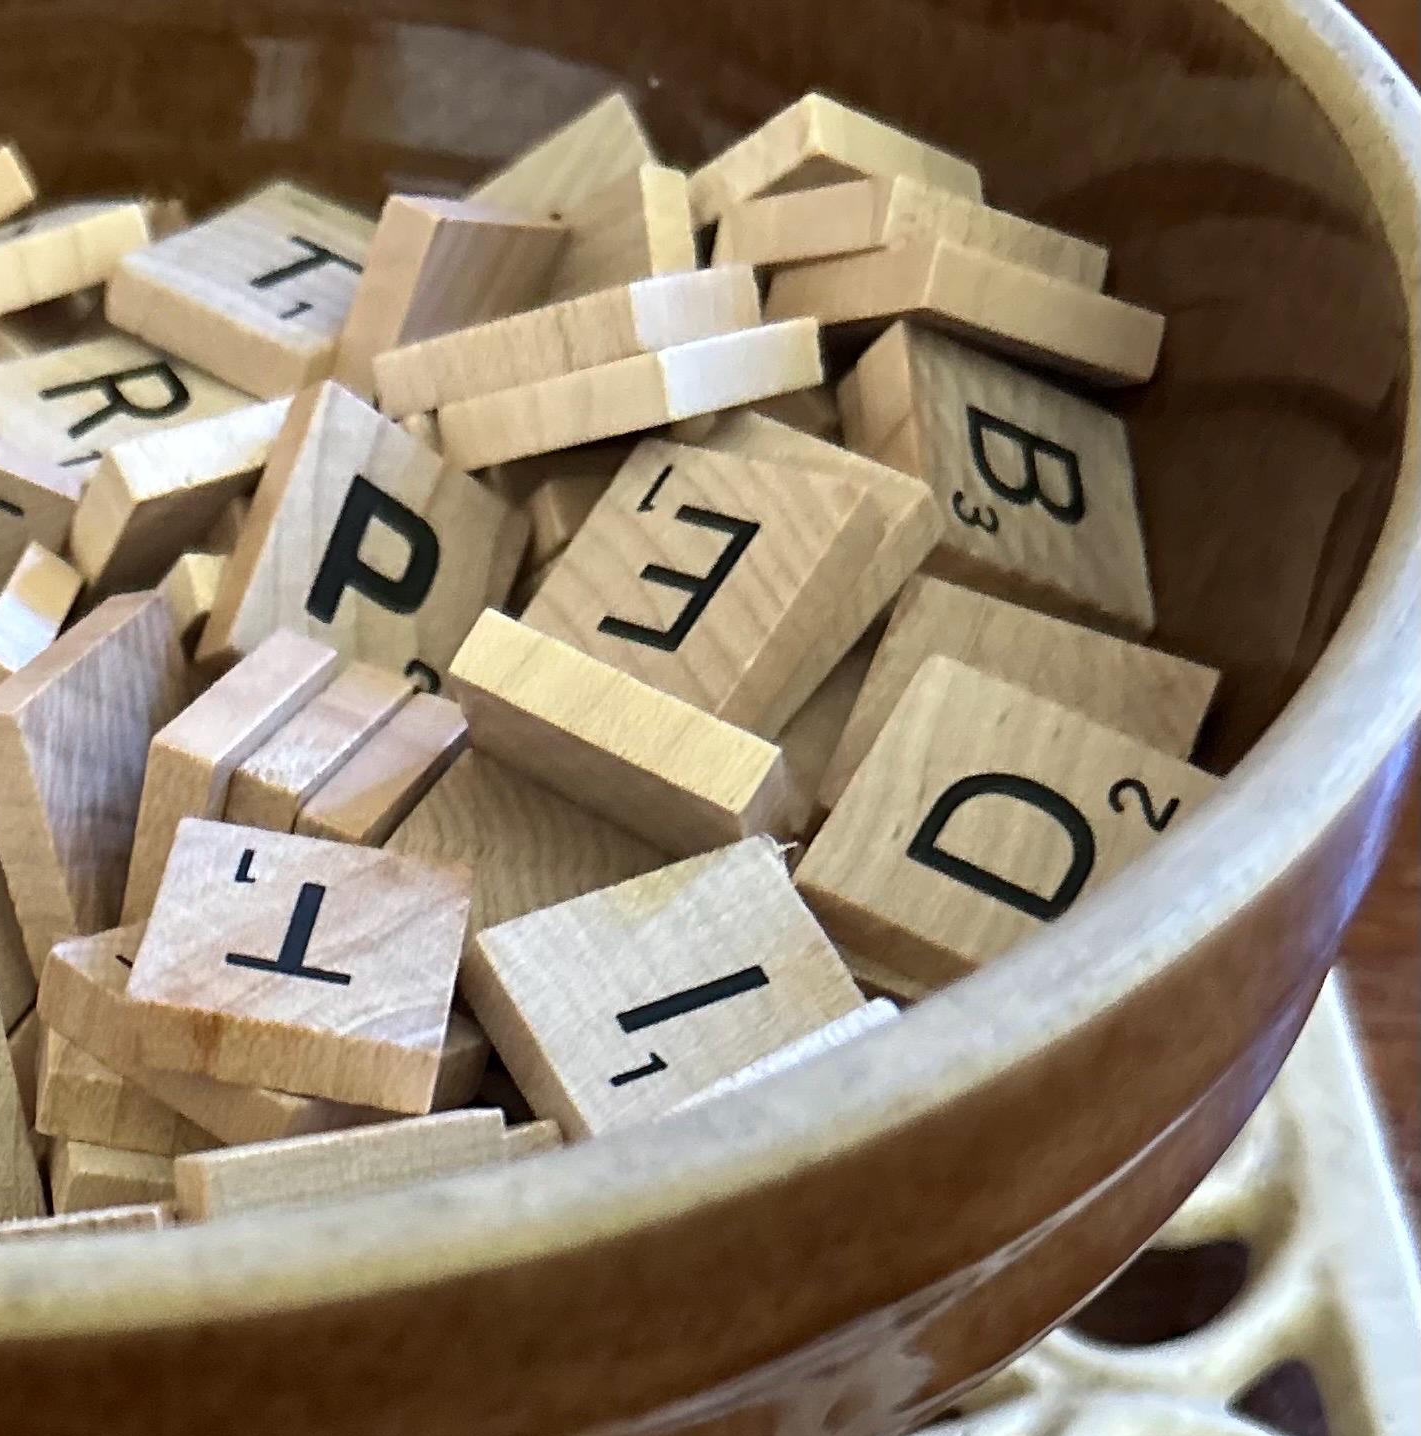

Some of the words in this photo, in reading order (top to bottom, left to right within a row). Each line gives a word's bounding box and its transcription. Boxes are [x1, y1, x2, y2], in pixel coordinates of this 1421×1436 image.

[251, 236, 363, 288] T
[39, 361, 191, 439] R
[637, 464, 673, 512] 1
[966, 406, 1088, 525] B
[305, 474, 440, 624] P
[953, 491, 999, 536] 3
[597, 505, 760, 652] E
[235, 849, 256, 883] 1
[906, 773, 1096, 923] D
[1109, 778, 1180, 832] 2
[225, 882, 351, 985] T
[610, 1053, 668, 1087] 1
